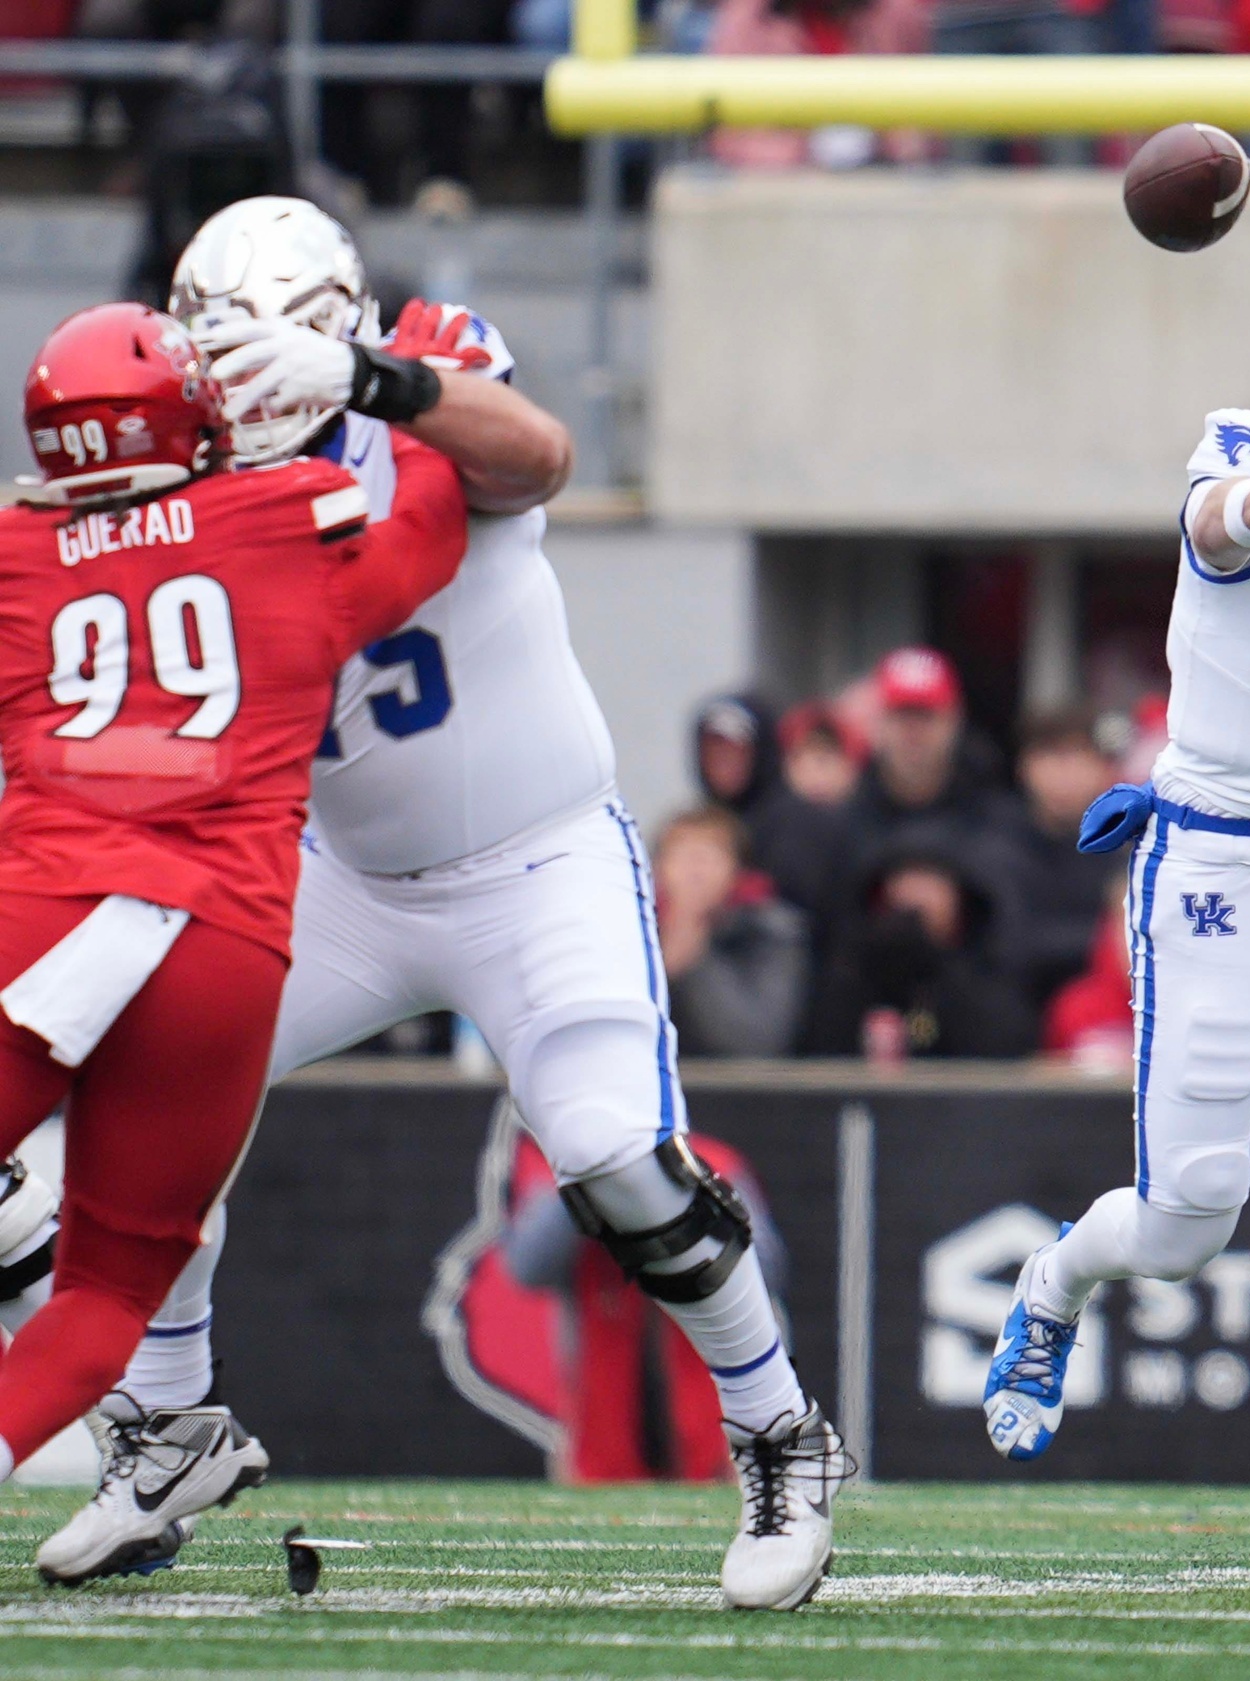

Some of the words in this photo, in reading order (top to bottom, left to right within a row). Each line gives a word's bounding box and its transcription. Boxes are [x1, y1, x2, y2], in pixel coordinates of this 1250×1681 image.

[60, 418, 108, 467] 99
[56, 498, 195, 567] GUERAD
[48, 573, 240, 740] 99
[1180, 892, 1238, 937] UK
[993, 1410, 1019, 1443] 2
